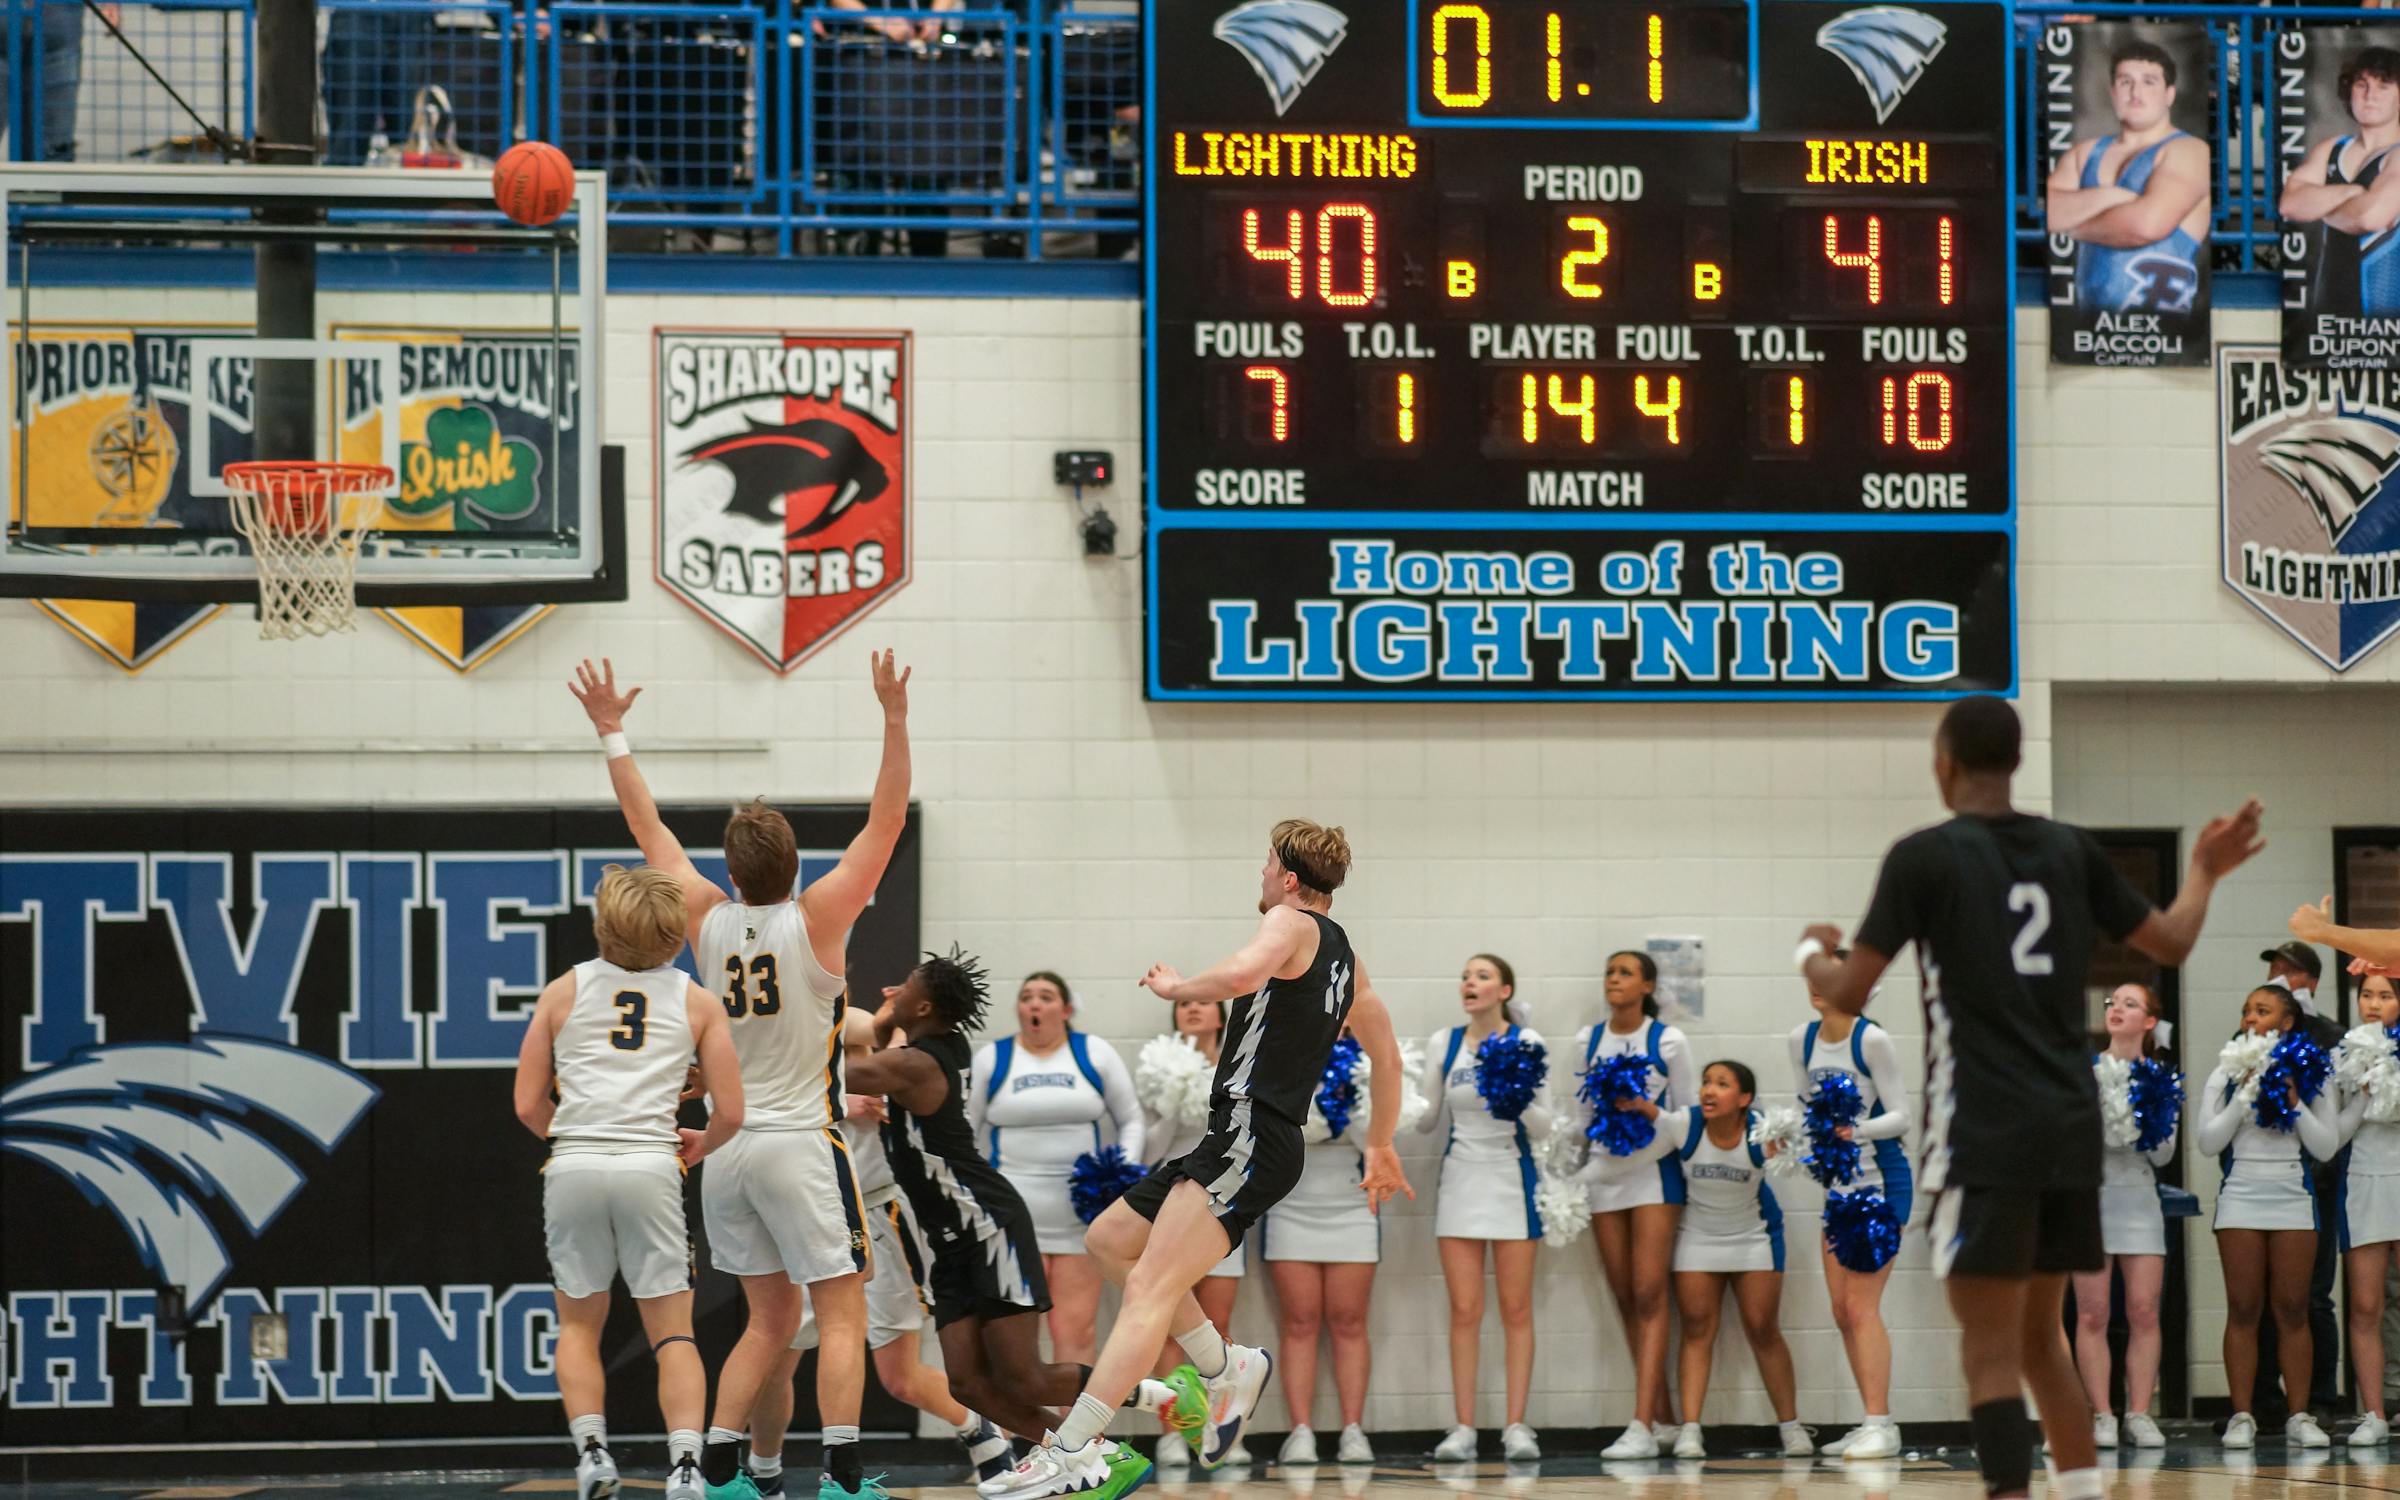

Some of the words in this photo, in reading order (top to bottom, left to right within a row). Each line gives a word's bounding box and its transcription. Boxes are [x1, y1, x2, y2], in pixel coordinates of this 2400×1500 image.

[1432, 5, 1663, 107] 01.1
[1174, 132, 1417, 178] LIGHTNING
[1523, 165, 1644, 202] PERIOD
[1805, 140, 1928, 184] IRISH
[1244, 203, 1376, 308] 40
[1447, 261, 1476, 298] B
[1561, 216, 1609, 298] 2
[1694, 263, 1721, 300] B
[1824, 215, 1952, 304] 41
[1194, 321, 1304, 358] FOULS
[1343, 323, 1436, 358] T.O.L.
[1469, 323, 1597, 360] PLAYER
[1616, 325, 1701, 361] FOUL
[1734, 326, 1826, 362] T.O.L.
[1862, 327, 1968, 363] FOULS
[2074, 331, 2182, 354] BACCOLI
[2095, 311, 2161, 333] ALEX
[2317, 314, 2400, 336] ETHAN
[667, 344, 898, 437] SHAKOPEE
[2327, 355, 2388, 369] CAPTAIN
[1246, 367, 1287, 441] 7
[1398, 373, 1414, 443] 1
[1522, 374, 1595, 444] 14
[1635, 375, 1681, 444] 4
[1789, 376, 1804, 445] 1
[1882, 372, 1951, 451] 10
[400, 432, 517, 504] Irish
[1195, 469, 1306, 505] SCORE
[1527, 471, 1644, 507] MATCH
[1861, 473, 1968, 509] SCORE
[680, 538, 885, 598] SABERS
[1329, 539, 1575, 596] Home
[1600, 540, 1685, 597] of
[1708, 540, 1844, 597] the
[1209, 598, 1960, 684] LIGHTNING
[2007, 882, 2053, 975] 2
[721, 951, 783, 1019] 33
[609, 989, 649, 1051] 3
